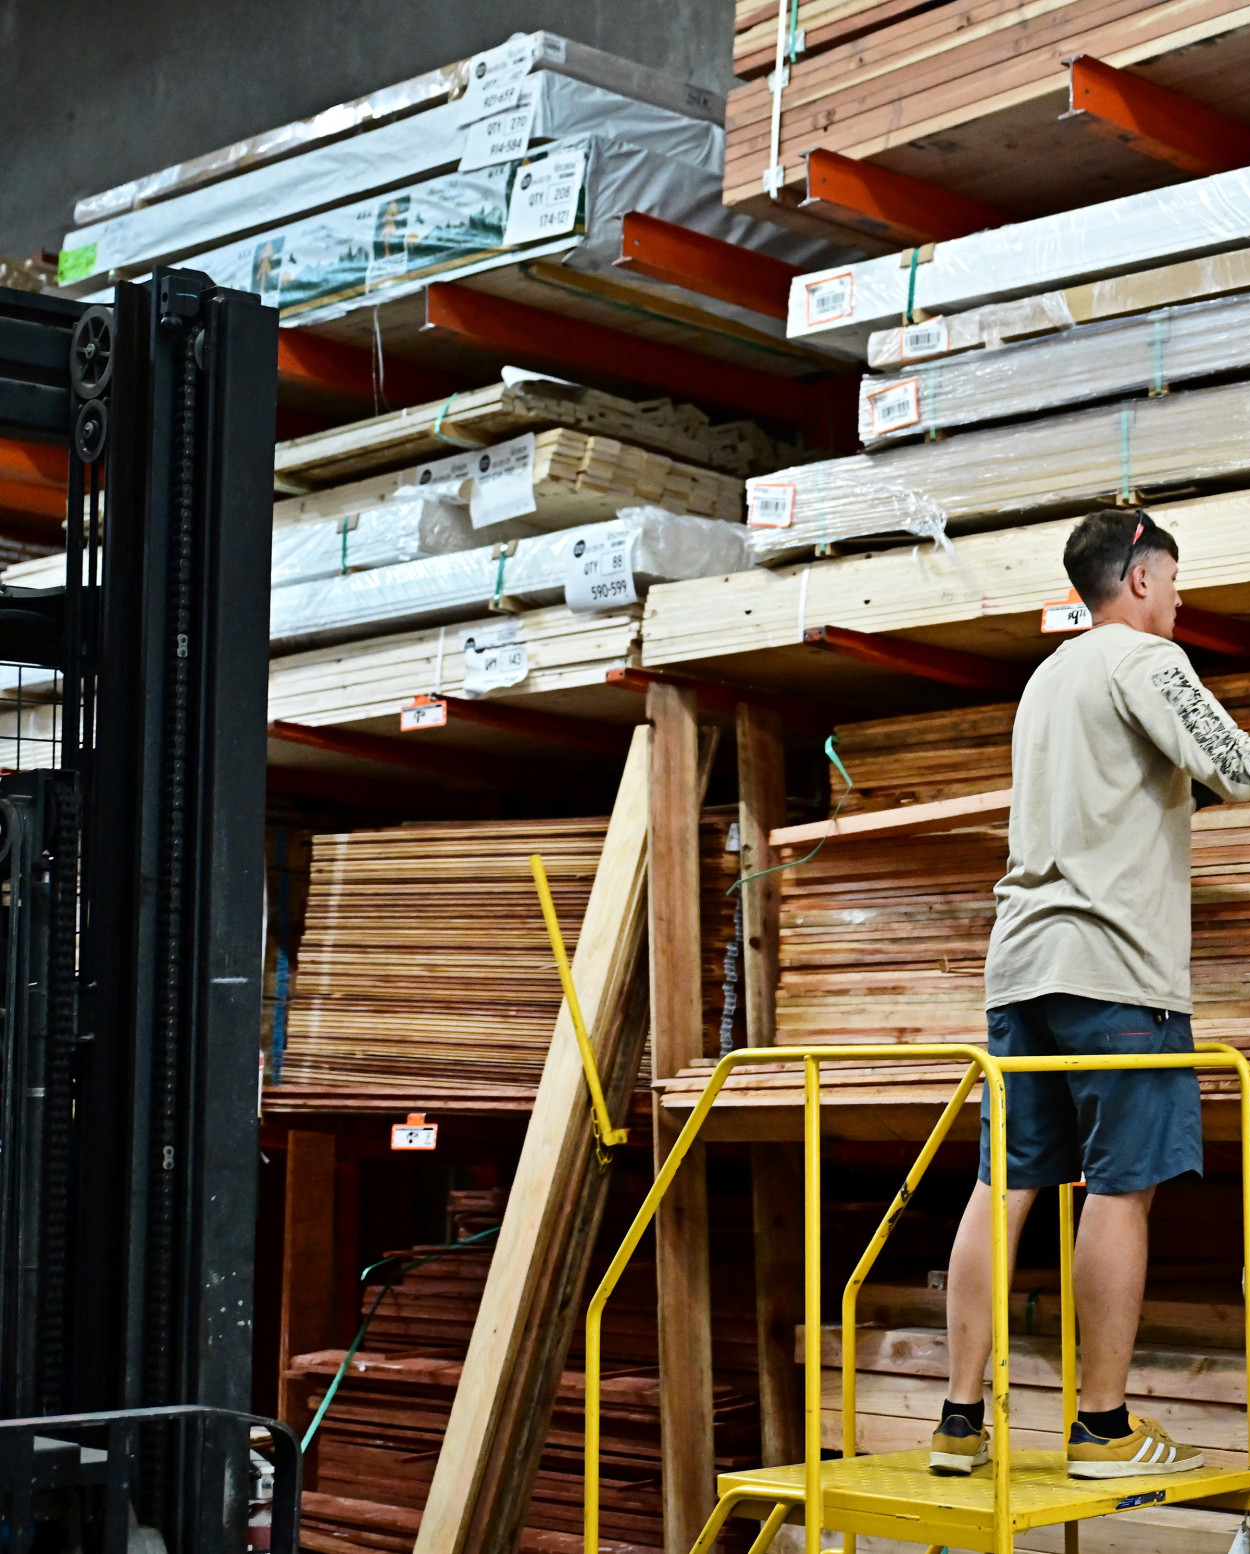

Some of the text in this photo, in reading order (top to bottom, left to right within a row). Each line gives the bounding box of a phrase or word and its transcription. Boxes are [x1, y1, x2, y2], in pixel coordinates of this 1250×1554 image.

[529, 191, 545, 207] QTY
[583, 561, 598, 575] QTY
[591, 579, 627, 600] 590-599
